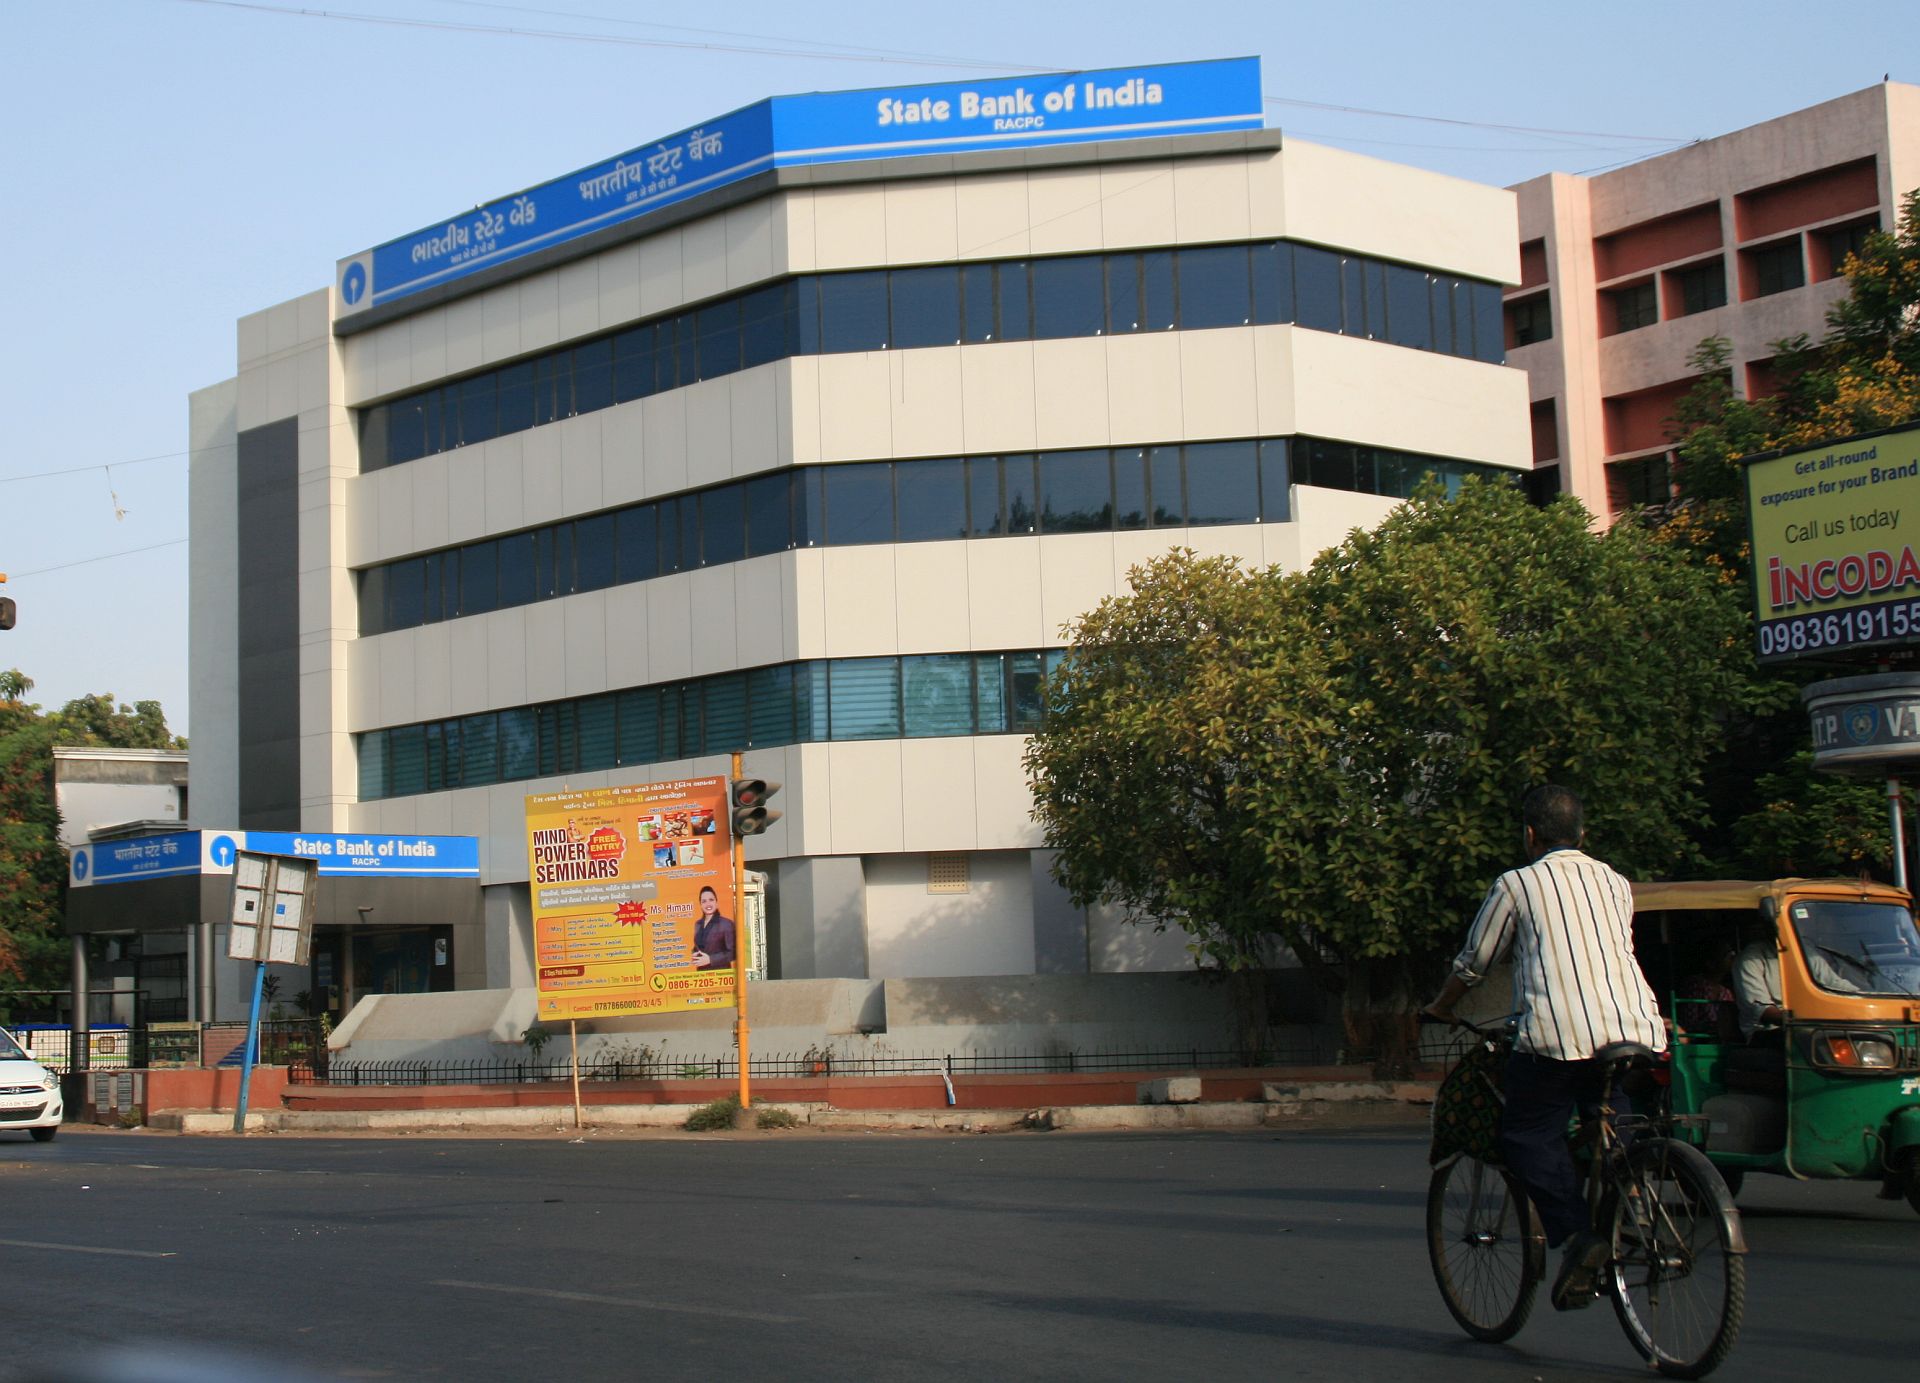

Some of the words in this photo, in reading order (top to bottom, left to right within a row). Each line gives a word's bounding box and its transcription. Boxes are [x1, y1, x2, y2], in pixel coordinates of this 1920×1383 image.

[878, 98, 950, 125] State
[960, 88, 1033, 119] Bank
[1043, 83, 1076, 112] of
[1086, 78, 1163, 108] India
[994, 116, 1045, 131] RACPC
[579, 161, 642, 200] भारतीय
[647, 144, 683, 177] स्टेट
[688, 129, 723, 160] बैंक
[412, 223, 469, 262] ભારતીય
[474, 210, 505, 240] સ્ટેટ
[509, 196, 536, 225] બેંક
[1795, 459, 1816, 475] Get
[1819, 446, 1877, 471] all-round
[1760, 487, 1815, 507] exposure
[1818, 480, 1836, 495] for
[1839, 476, 1867, 493] your
[1870, 460, 1918, 484] Brand
[1785, 520, 1818, 544] Call
[1824, 519, 1845, 537] us
[1850, 508, 1900, 531] today
[293, 838, 332, 855] State
[336, 839, 374, 856] Bank
[378, 841, 394, 856] of
[398, 841, 436, 857] India
[533, 829, 567, 846] MIND
[590, 842, 620, 852] ENTRY
[593, 834, 617, 844] FREE
[115, 844, 143, 860] भारतीय
[145, 841, 161, 857] स्टेट
[162, 838, 178, 855] बैंक
[534, 843, 586, 864] POWER
[352, 858, 380, 866] RACPC
[536, 859, 619, 883] SEMINARS
[666, 903, 693, 913] Himani
